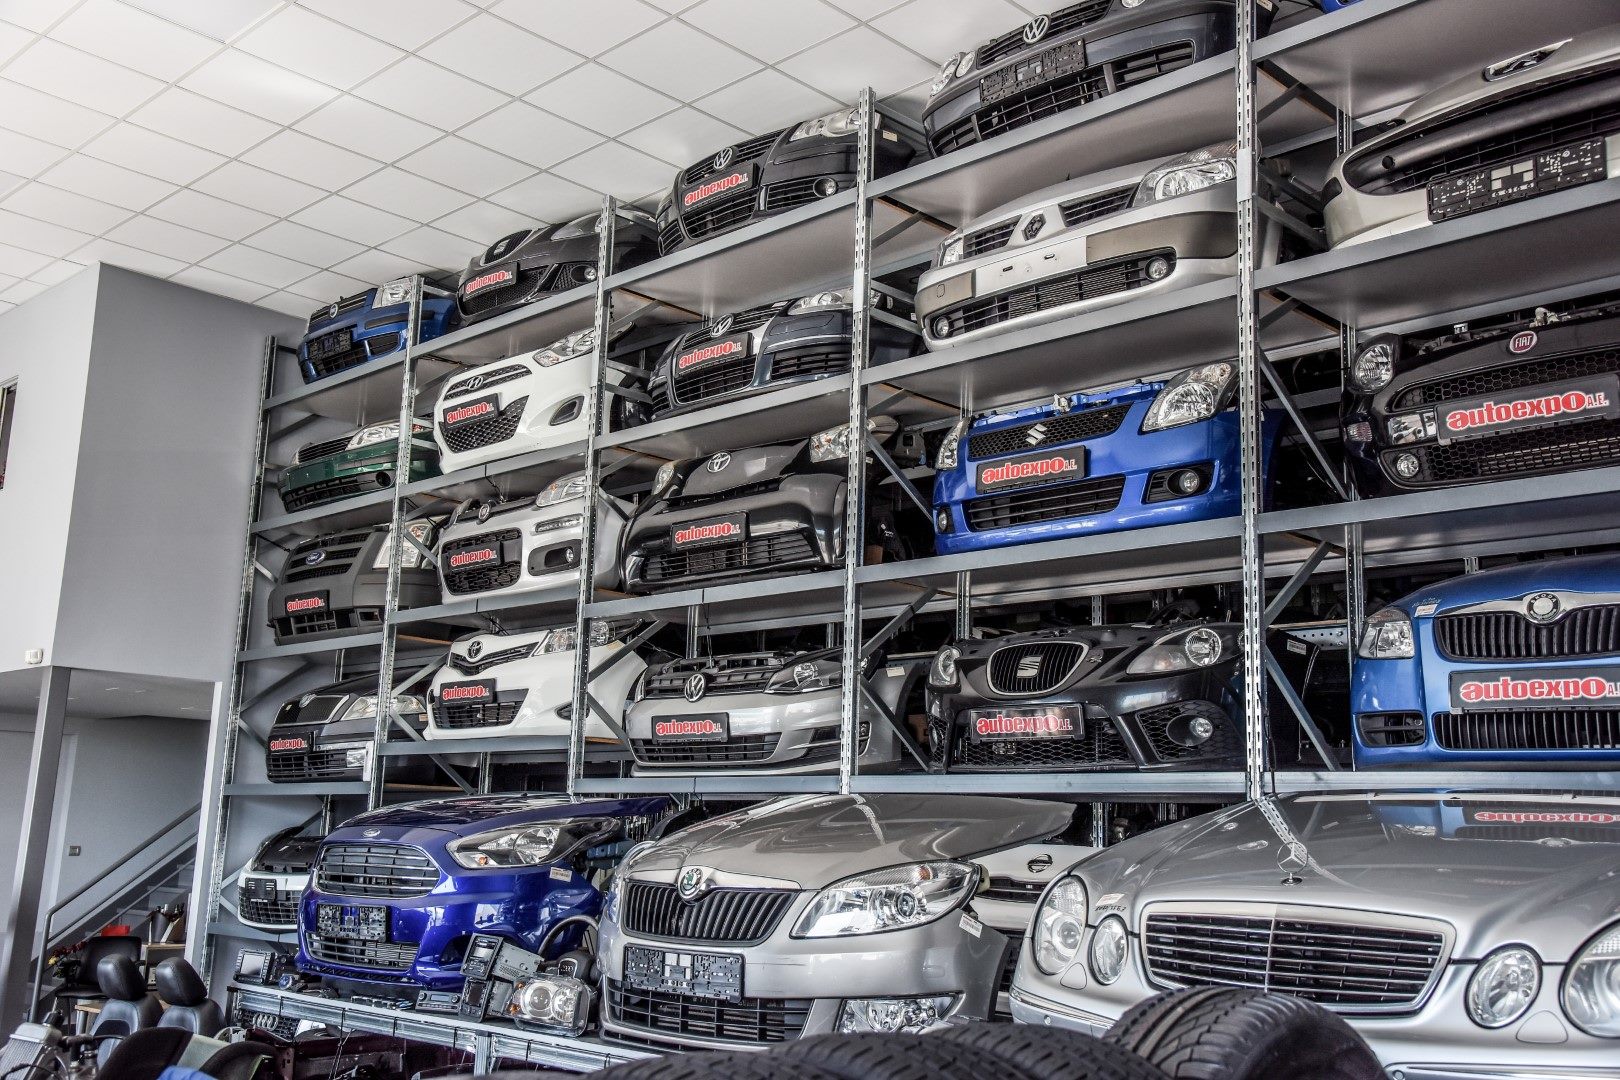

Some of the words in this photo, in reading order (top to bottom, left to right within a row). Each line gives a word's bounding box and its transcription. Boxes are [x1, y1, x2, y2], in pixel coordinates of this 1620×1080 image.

[684, 173, 741, 206] autoexpo
[1515, 334, 1533, 348] FIAT
[679, 341, 734, 369] autoexpo
[1446, 391, 1586, 431] autoexpo
[982, 457, 1065, 484] autoexpo
[675, 522, 732, 543] autoexpo
[1460, 677, 1607, 701] autoexpo
[1606, 681, 1620, 697] A.
[656, 719, 714, 736] autoexpo
[977, 715, 1059, 735] autoexpo
